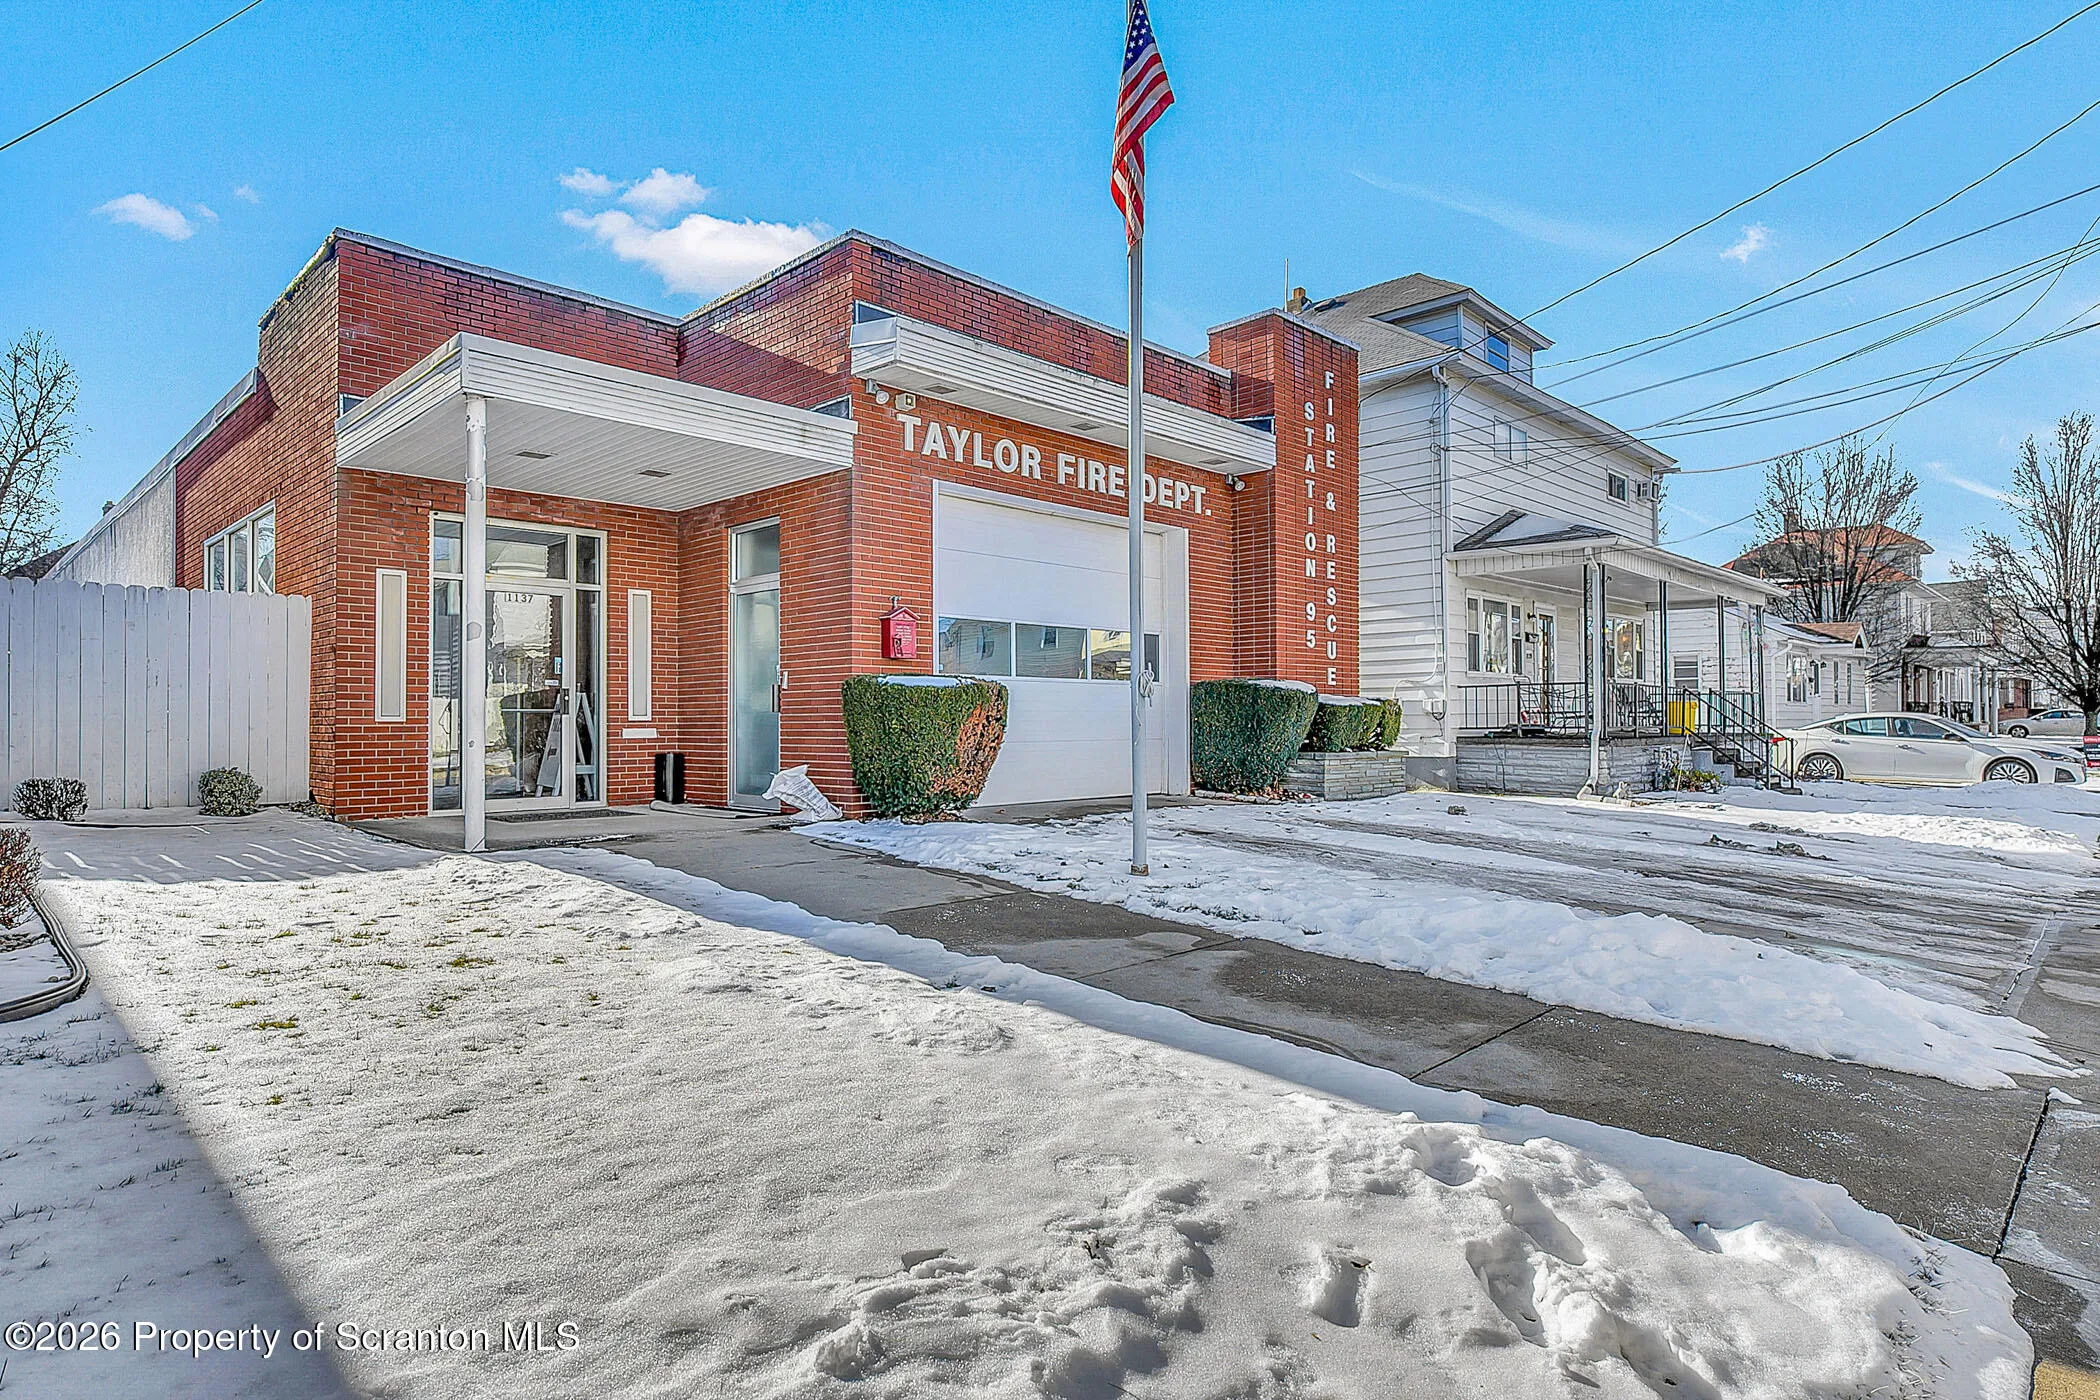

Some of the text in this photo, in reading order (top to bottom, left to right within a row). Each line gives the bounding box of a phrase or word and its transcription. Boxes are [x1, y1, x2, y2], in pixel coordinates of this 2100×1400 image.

[896, 413, 1042, 480] TAYLOR
[1056, 452, 1126, 498] FIRE
[1304, 401, 1317, 649] STATION 95
[1324, 371, 1337, 686] FIRE & RESCUE
